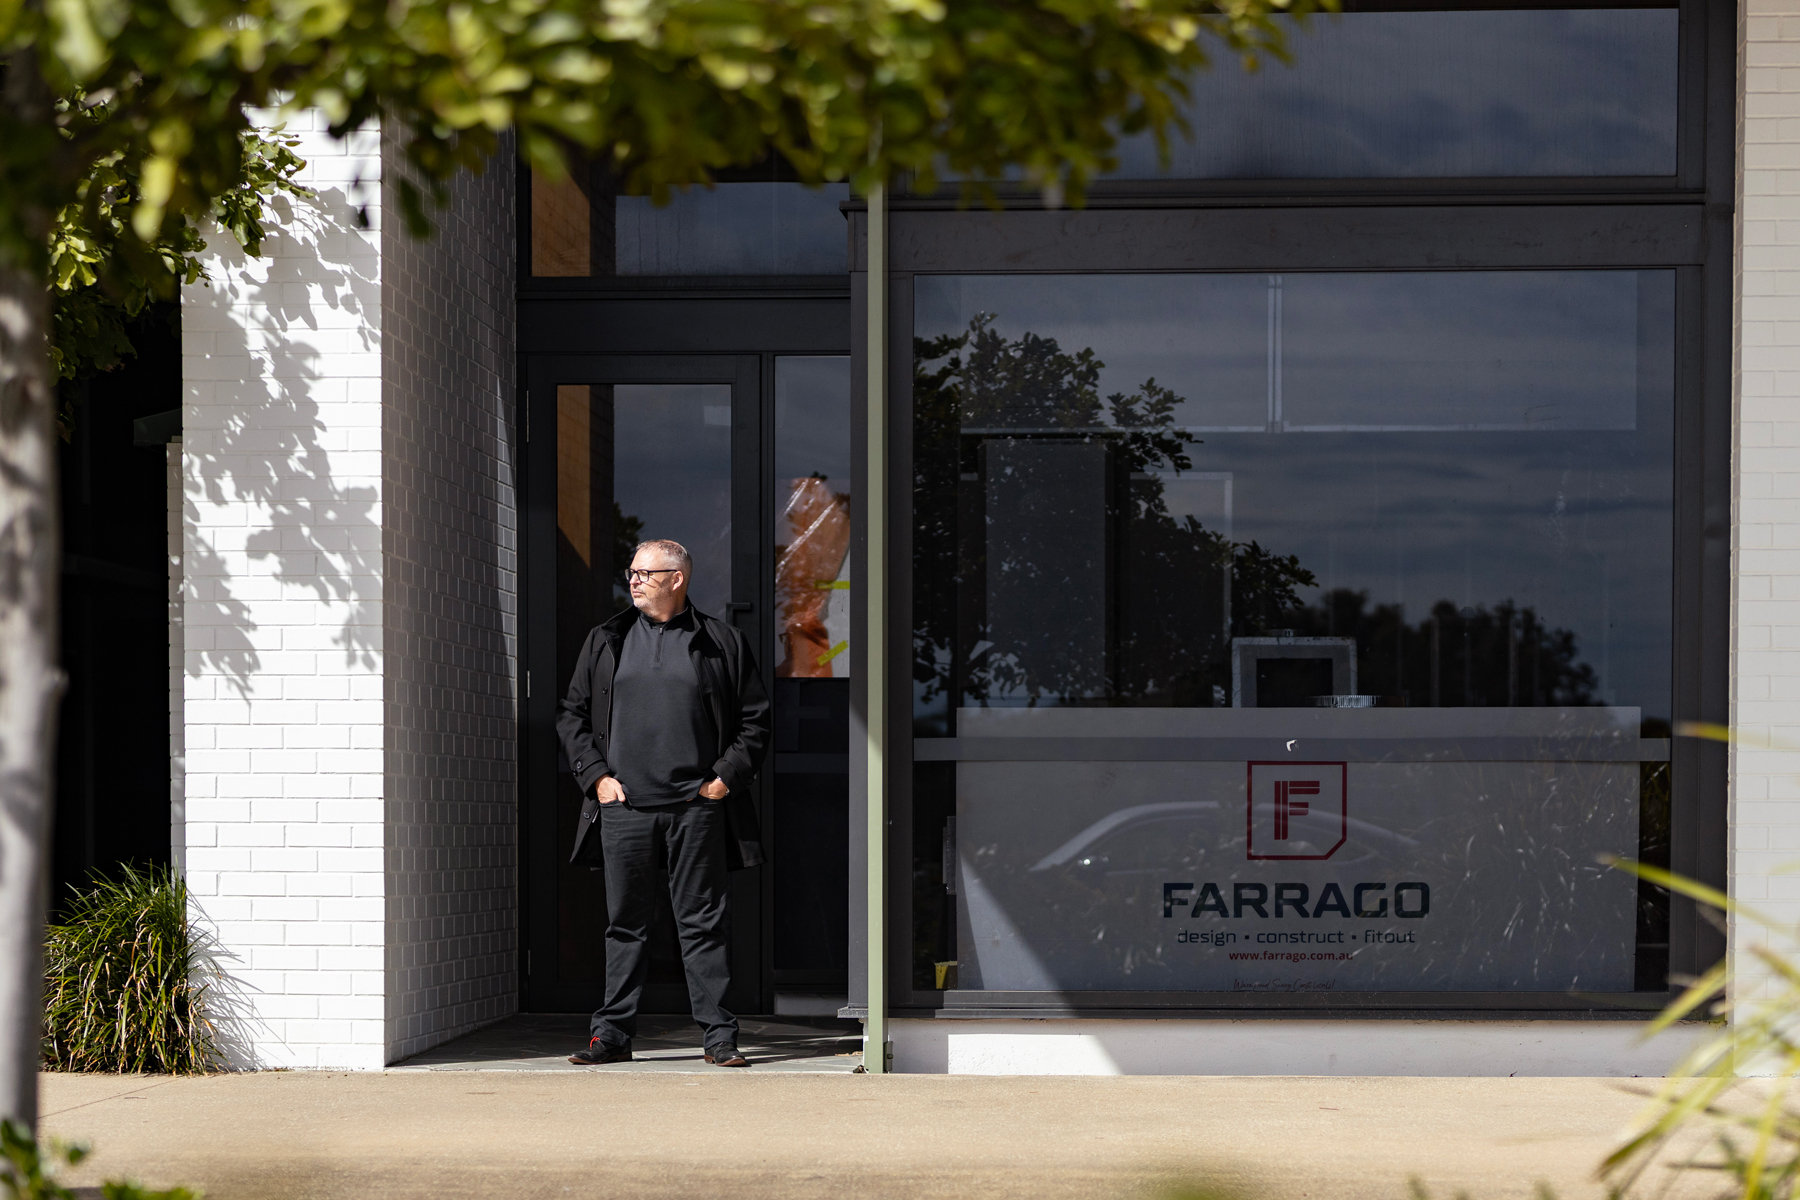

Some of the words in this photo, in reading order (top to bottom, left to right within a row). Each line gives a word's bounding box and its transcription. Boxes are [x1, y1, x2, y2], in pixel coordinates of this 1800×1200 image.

[1274, 781, 1320, 840] F
[1163, 882, 1430, 918] FARRAGO
[1178, 930, 1236, 946] design
[1257, 930, 1344, 943] construct
[1364, 929, 1415, 943] fitout
[1229, 951, 1353, 962] www.farrago.com.au
